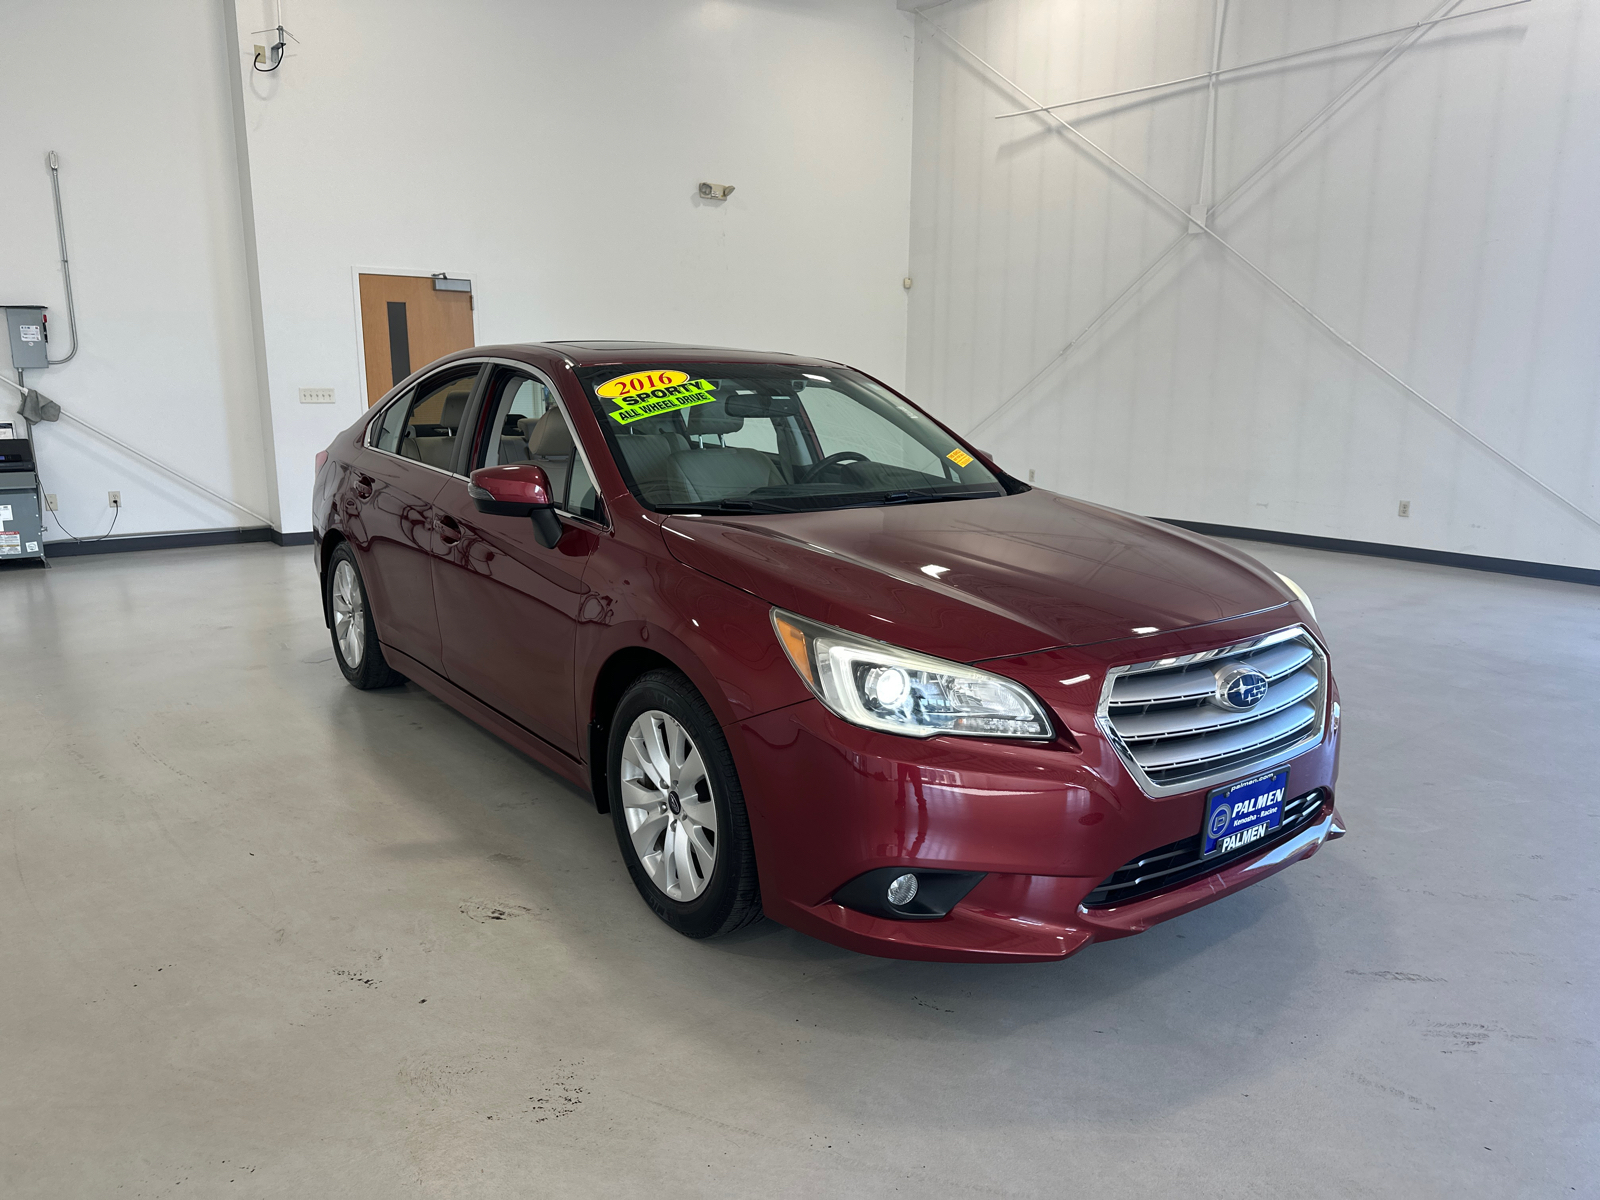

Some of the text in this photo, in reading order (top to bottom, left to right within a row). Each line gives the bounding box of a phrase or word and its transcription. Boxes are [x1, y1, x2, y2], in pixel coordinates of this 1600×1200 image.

[614, 372, 672, 395] 2016
[622, 381, 703, 405] SPORTY
[618, 392, 707, 420] ALL WHEEL DRIVE
[1231, 773, 1274, 792] palmen.com
[1232, 787, 1284, 818] PALMEN
[1233, 814, 1257, 827] Kenosha
[1260, 807, 1278, 818] Racine
[1222, 823, 1266, 852] PALMEN
